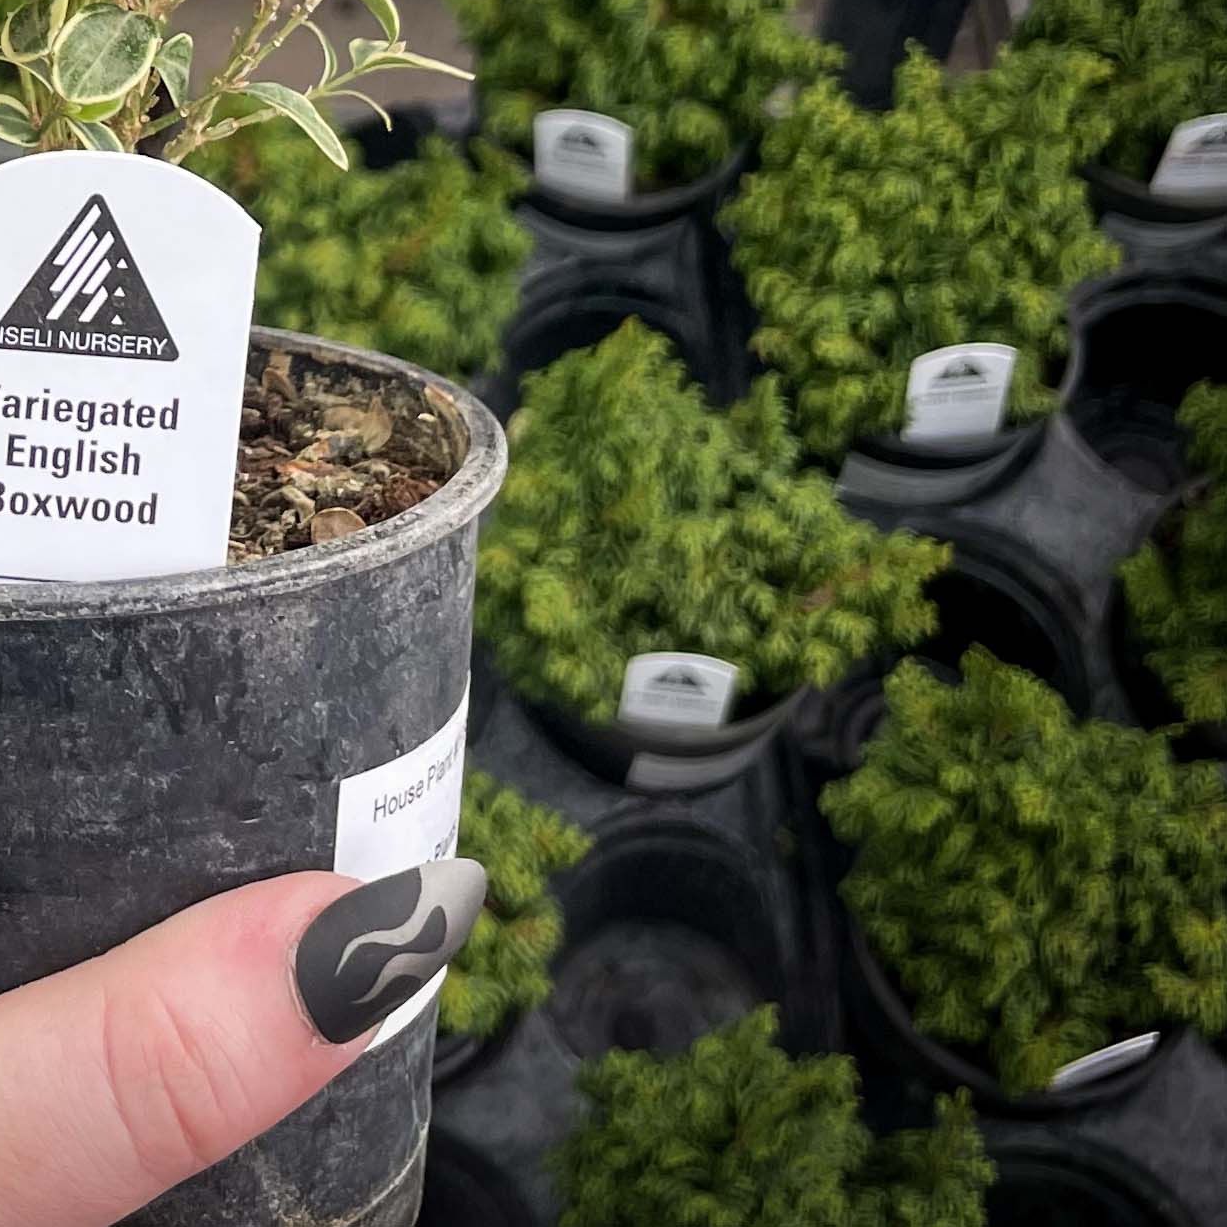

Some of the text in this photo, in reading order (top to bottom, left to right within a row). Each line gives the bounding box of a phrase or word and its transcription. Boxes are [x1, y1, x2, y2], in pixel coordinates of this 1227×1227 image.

[58, 329, 168, 356] NURSERY
[5, 433, 142, 479] English
[373, 779, 424, 823] House
